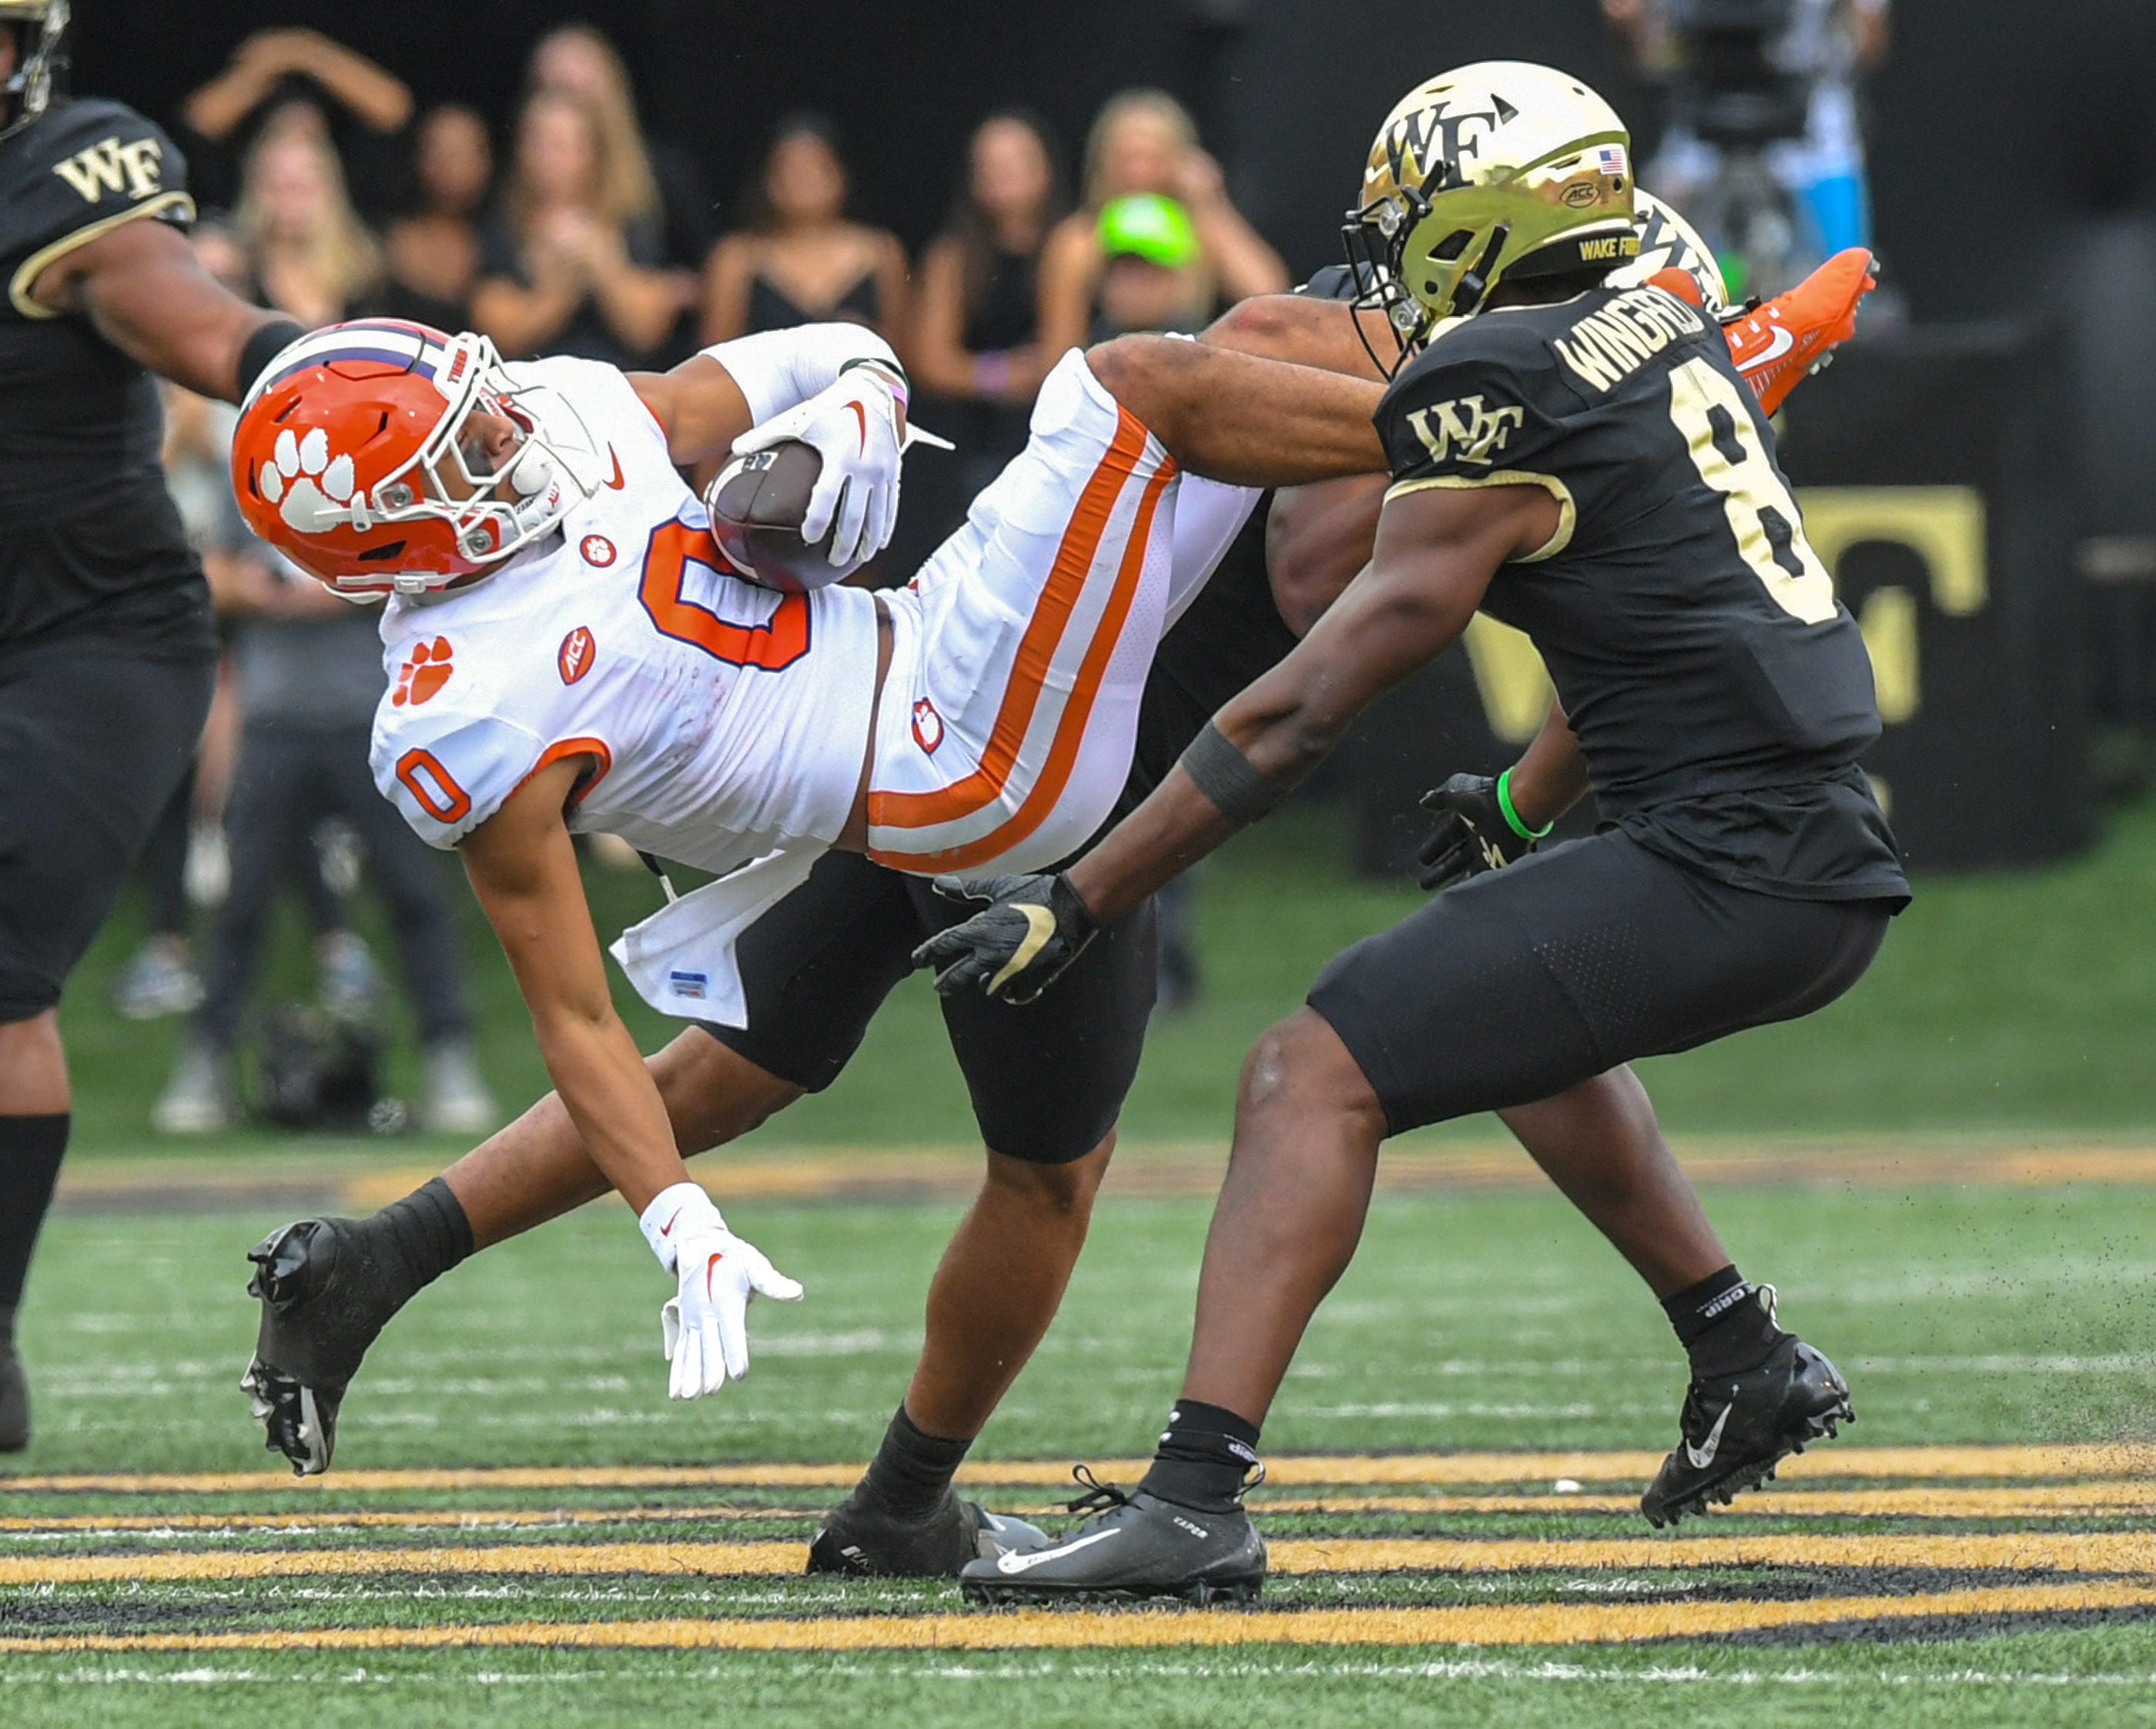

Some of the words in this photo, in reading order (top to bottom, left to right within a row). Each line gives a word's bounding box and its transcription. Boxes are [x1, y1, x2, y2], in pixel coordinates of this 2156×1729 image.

[52, 136, 163, 203] WF
[1386, 101, 1495, 192] WF
[1579, 238, 1617, 261] WAKE
[1406, 394, 1524, 465] WF
[1668, 356, 1838, 625] 8
[637, 516, 812, 673] 0
[565, 630, 586, 677] ACC
[396, 747, 471, 824] 0
